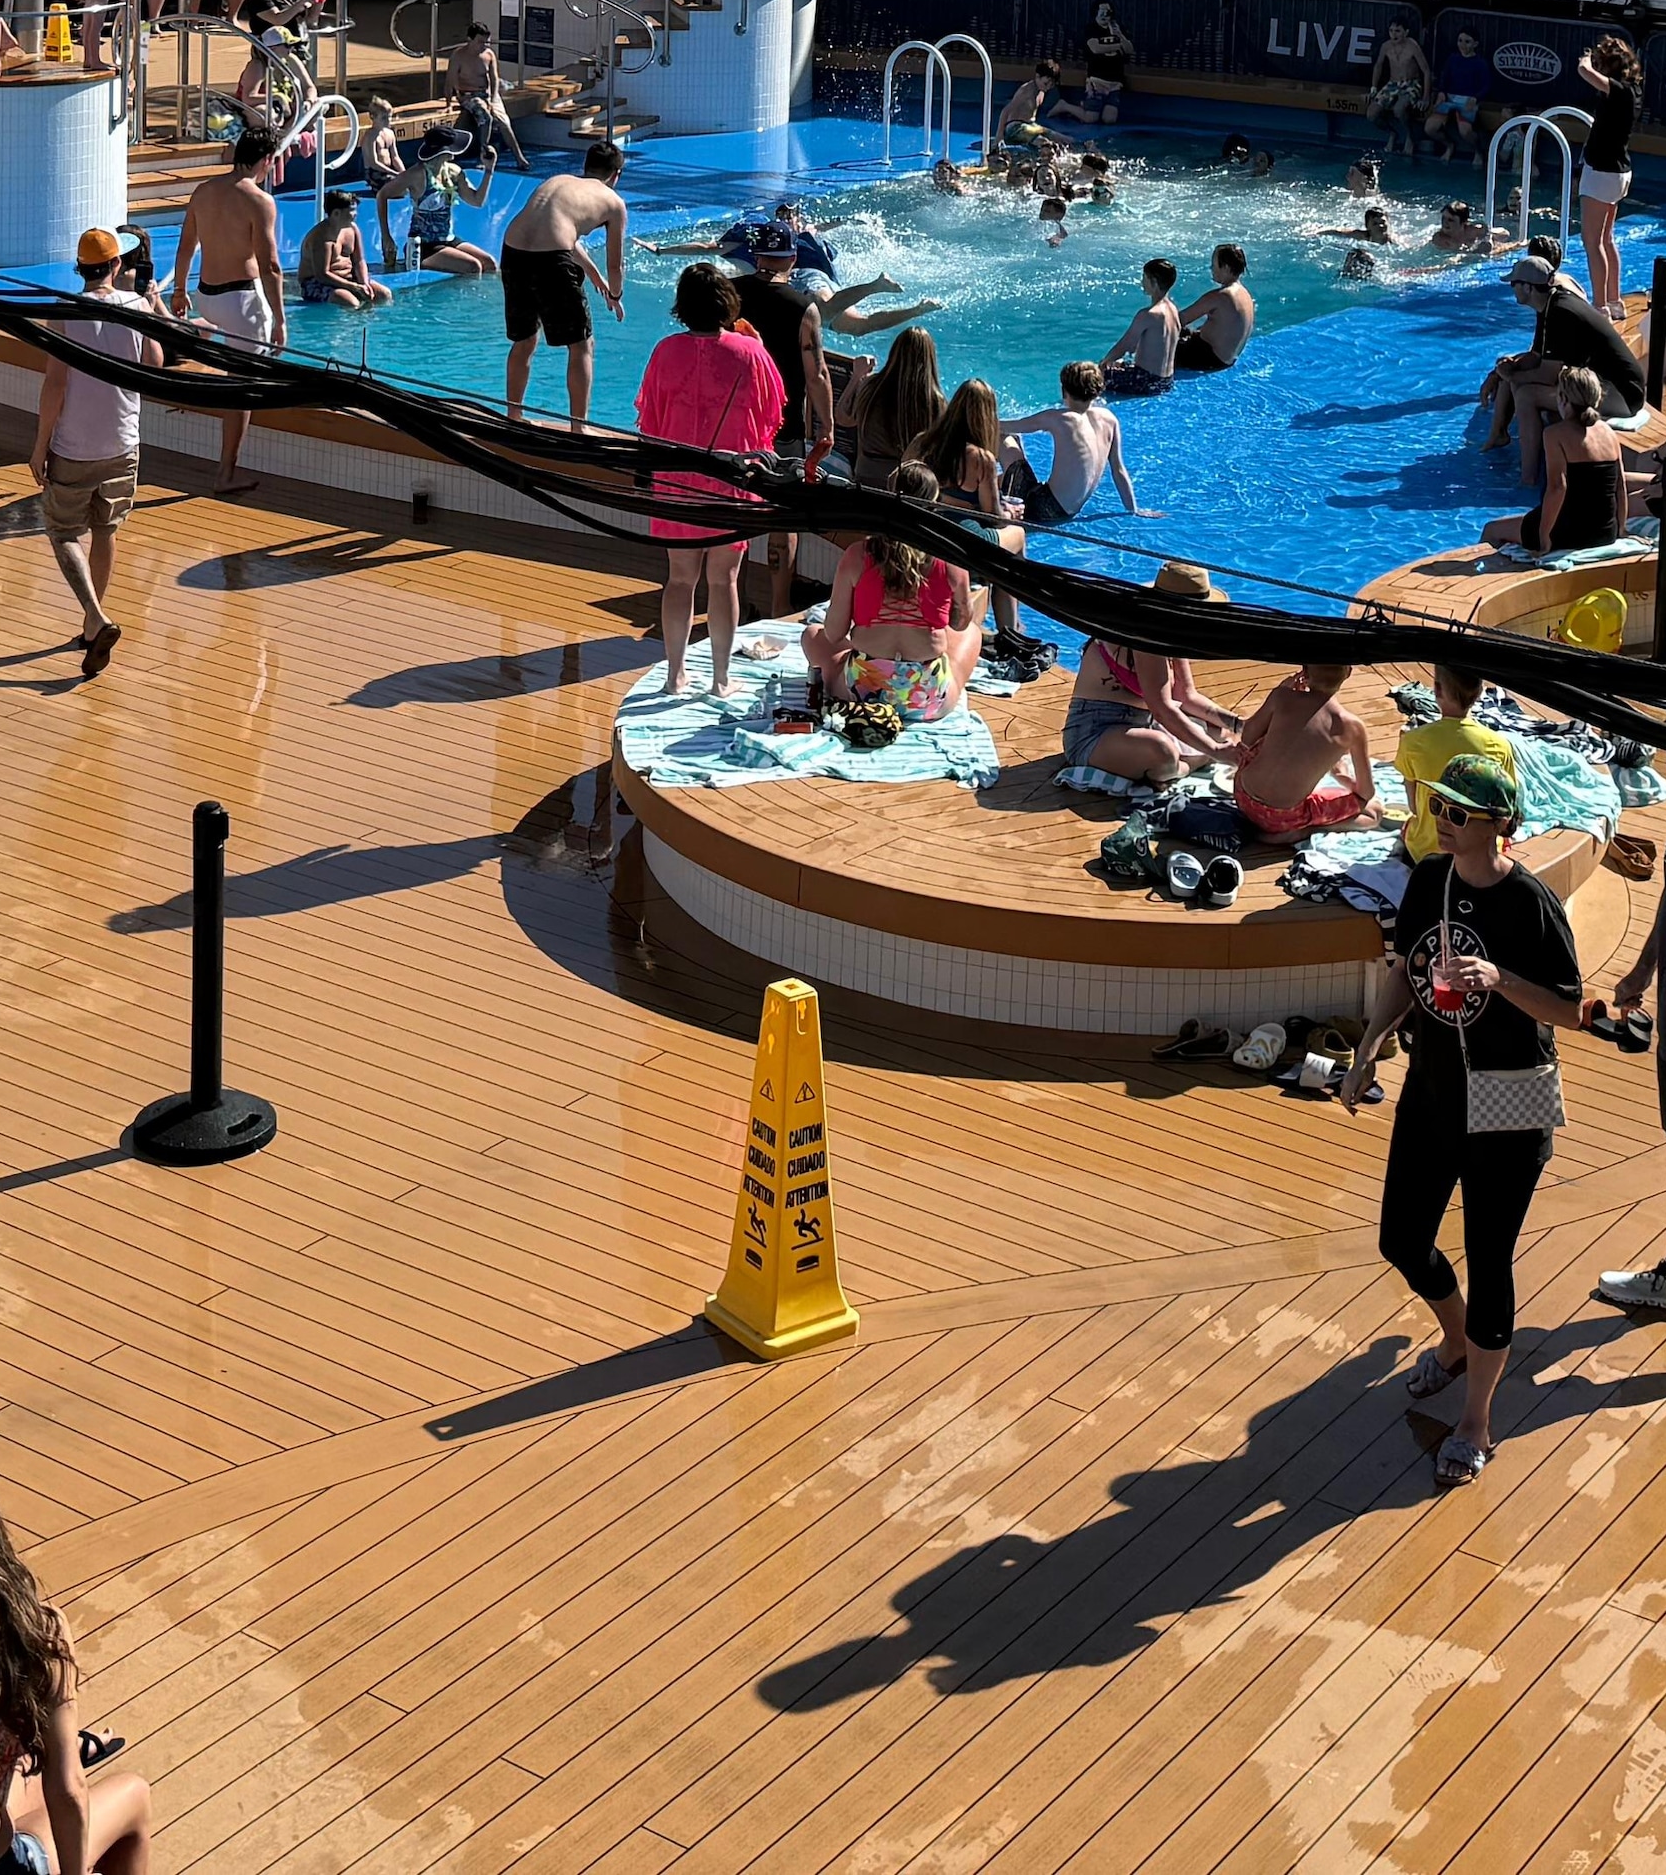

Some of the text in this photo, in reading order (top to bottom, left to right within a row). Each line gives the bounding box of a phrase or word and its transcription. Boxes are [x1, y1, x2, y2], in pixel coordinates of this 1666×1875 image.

[1266, 17, 1375, 64] LIVE
[1498, 56, 1556, 73] SIXTHMAN
[789, 1121, 823, 1150] CAUTION
[787, 1150, 825, 1179] CUIDADO
